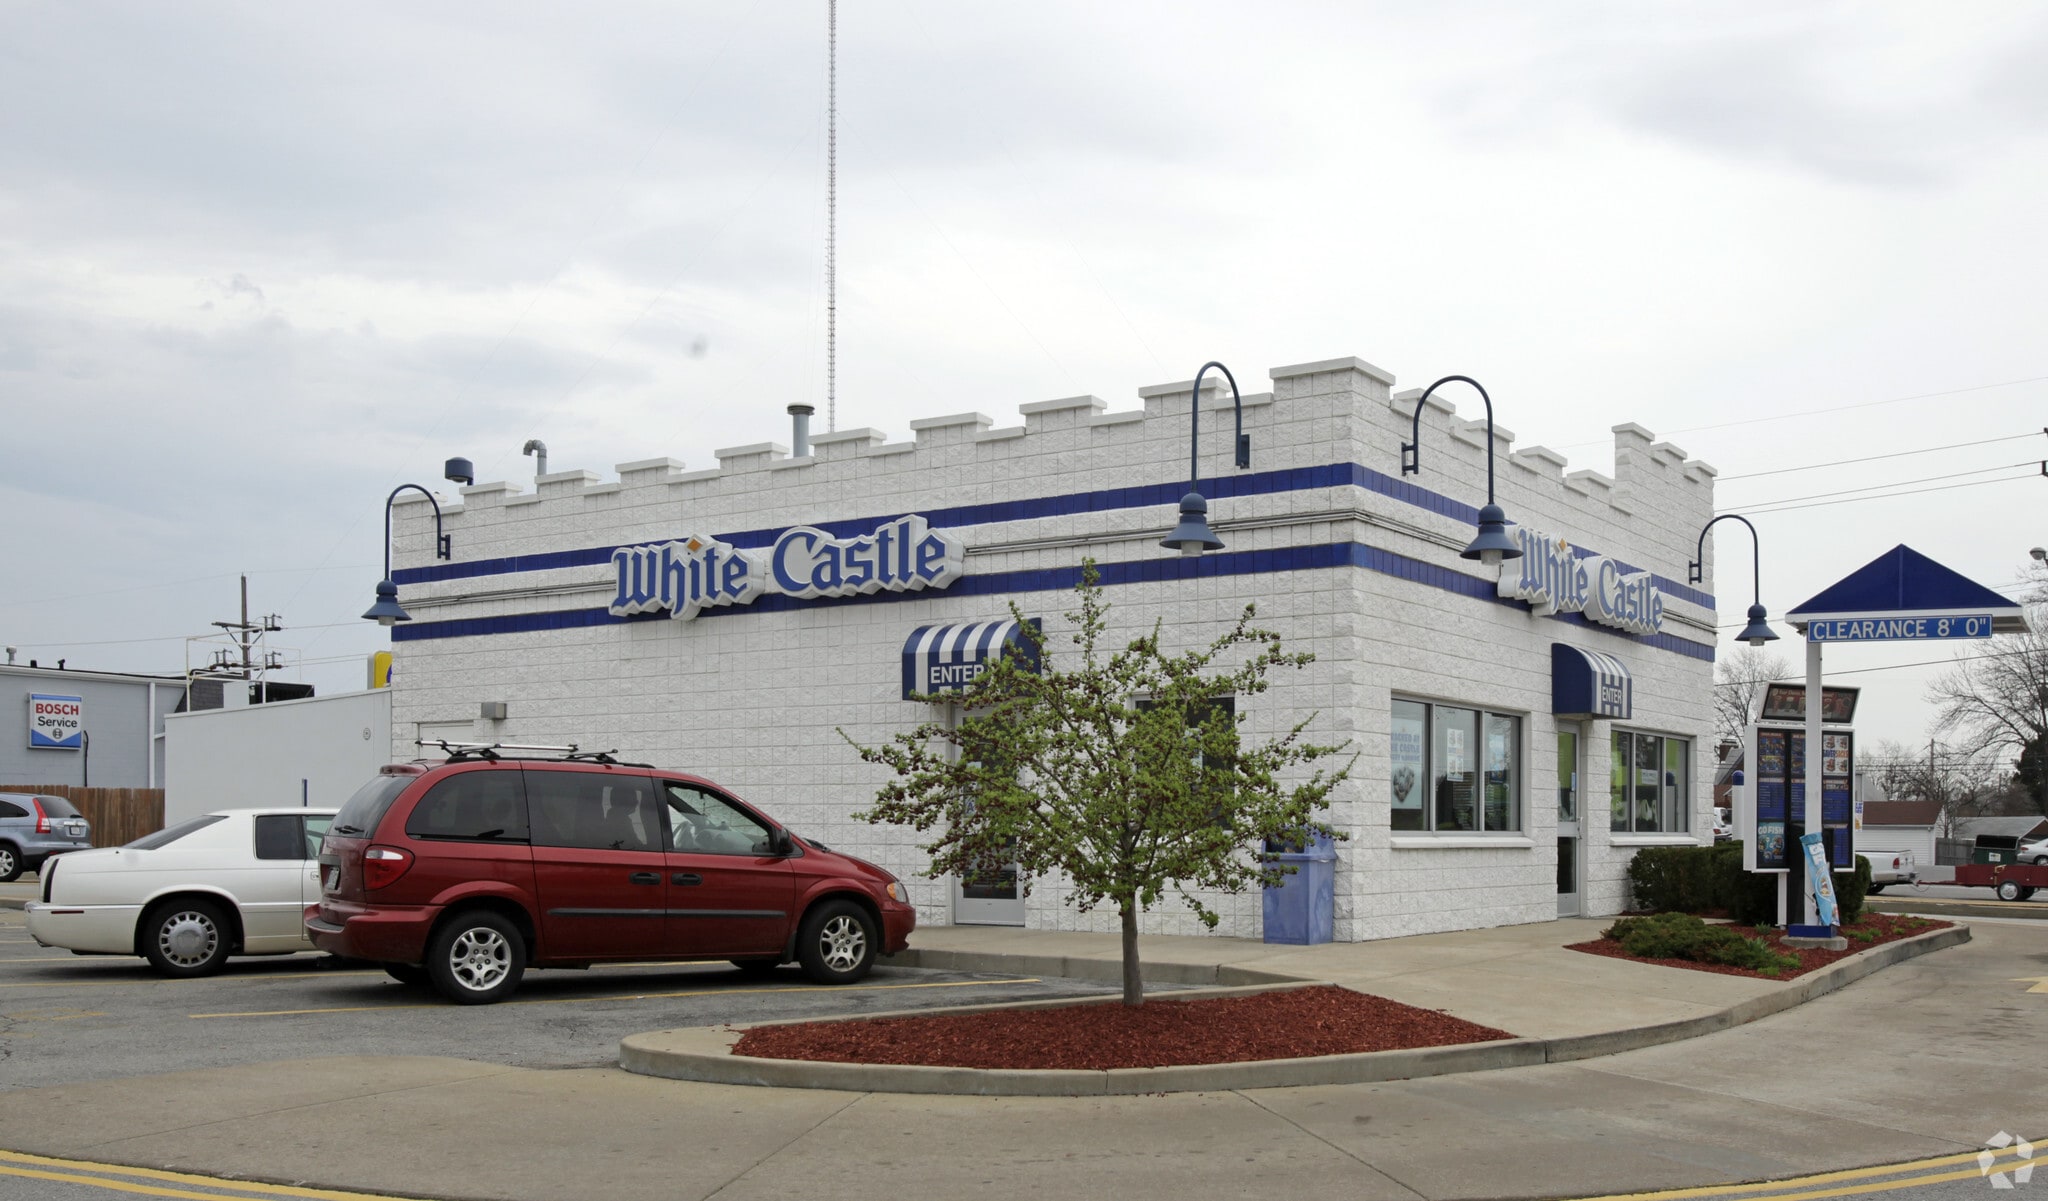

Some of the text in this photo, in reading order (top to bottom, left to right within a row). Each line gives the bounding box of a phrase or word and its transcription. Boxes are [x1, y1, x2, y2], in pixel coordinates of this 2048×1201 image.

[612, 520, 945, 615] White Castle
[1519, 528, 1663, 631] White Castle
[1813, 619, 1928, 640] CLEARANCE
[1937, 618, 1956, 637] 8'
[1602, 686, 1622, 704] ENTER
[35, 703, 79, 715] BOSCH
[37, 715, 78, 728] Service
